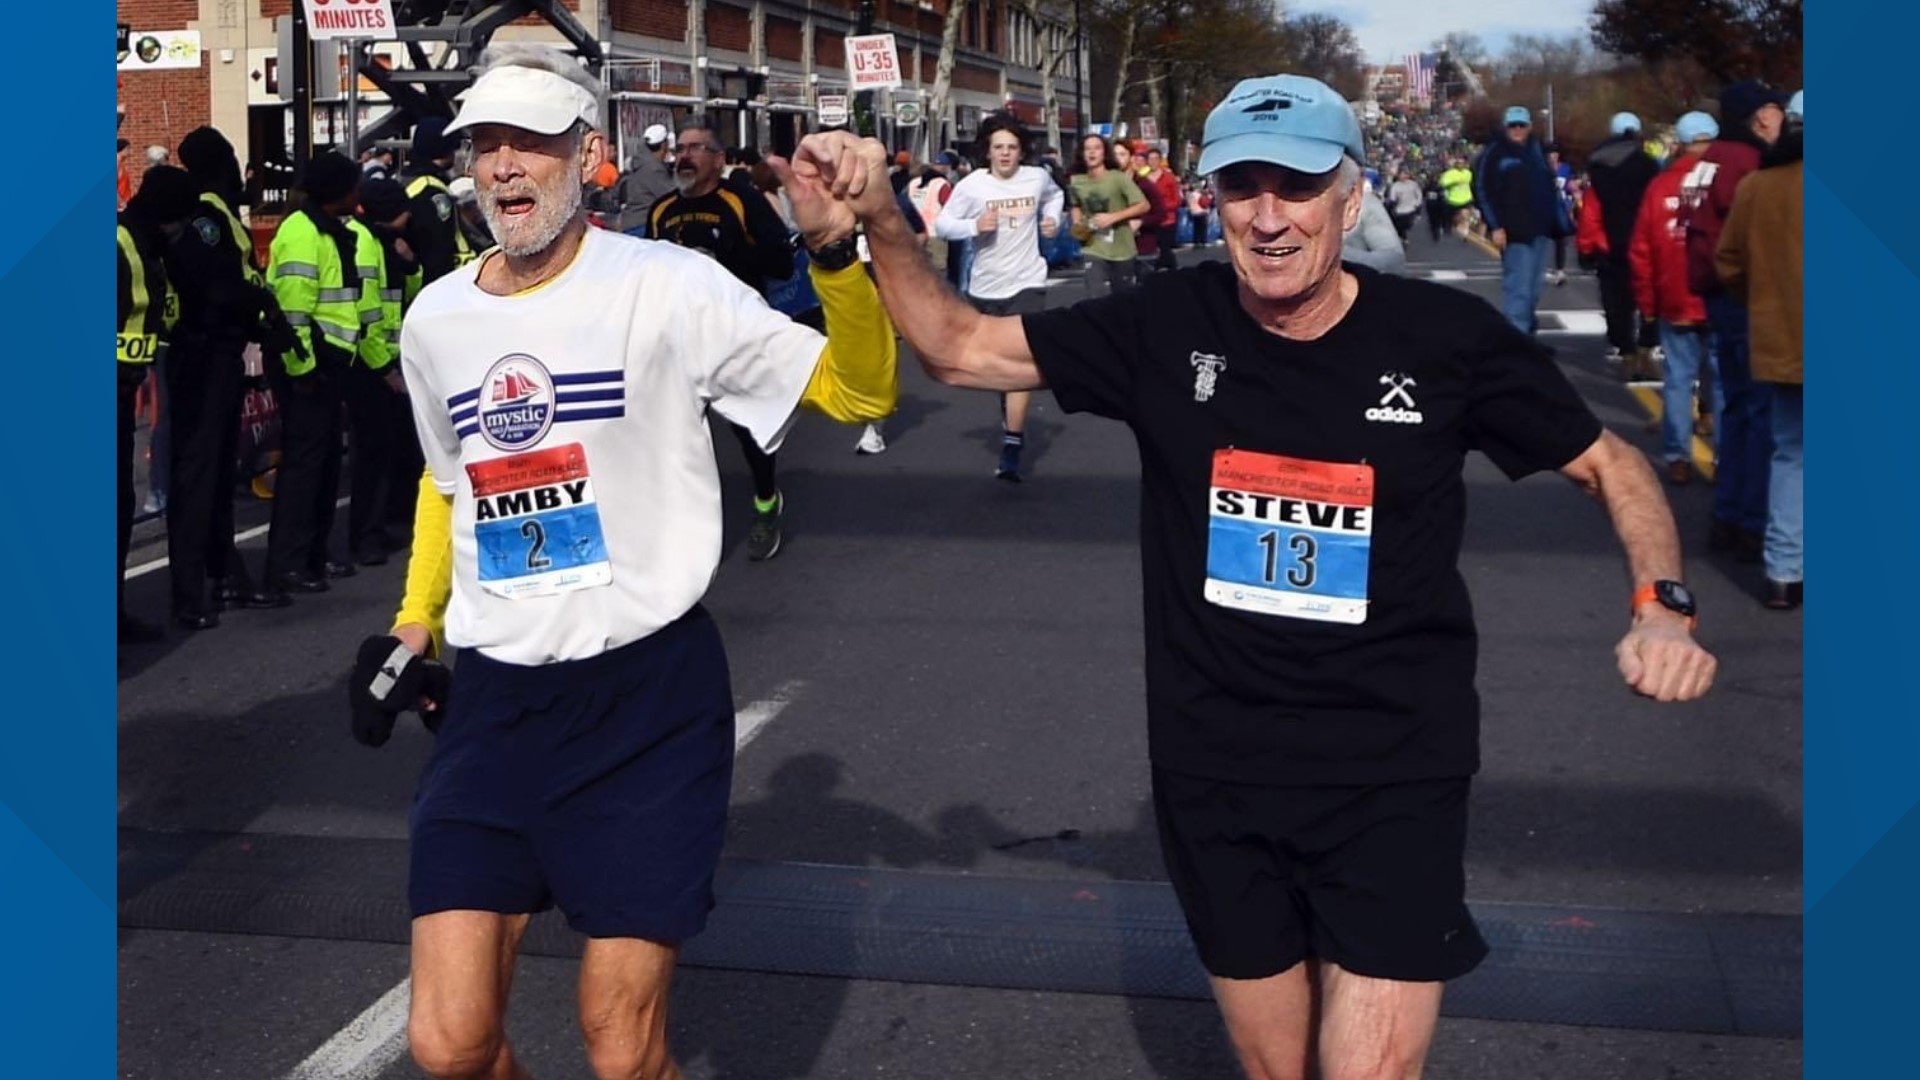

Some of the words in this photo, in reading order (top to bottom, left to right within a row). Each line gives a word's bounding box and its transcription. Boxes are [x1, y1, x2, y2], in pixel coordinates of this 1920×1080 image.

[314, 8, 386, 29] MINUTES
[854, 51, 893, 71] U-35
[486, 406, 545, 440] mystic
[1365, 406, 1423, 424] adidas
[477, 480, 587, 520] AMBY
[1216, 490, 1366, 531] STEVE
[521, 519, 551, 569] 2
[1258, 529, 1317, 588] 13
